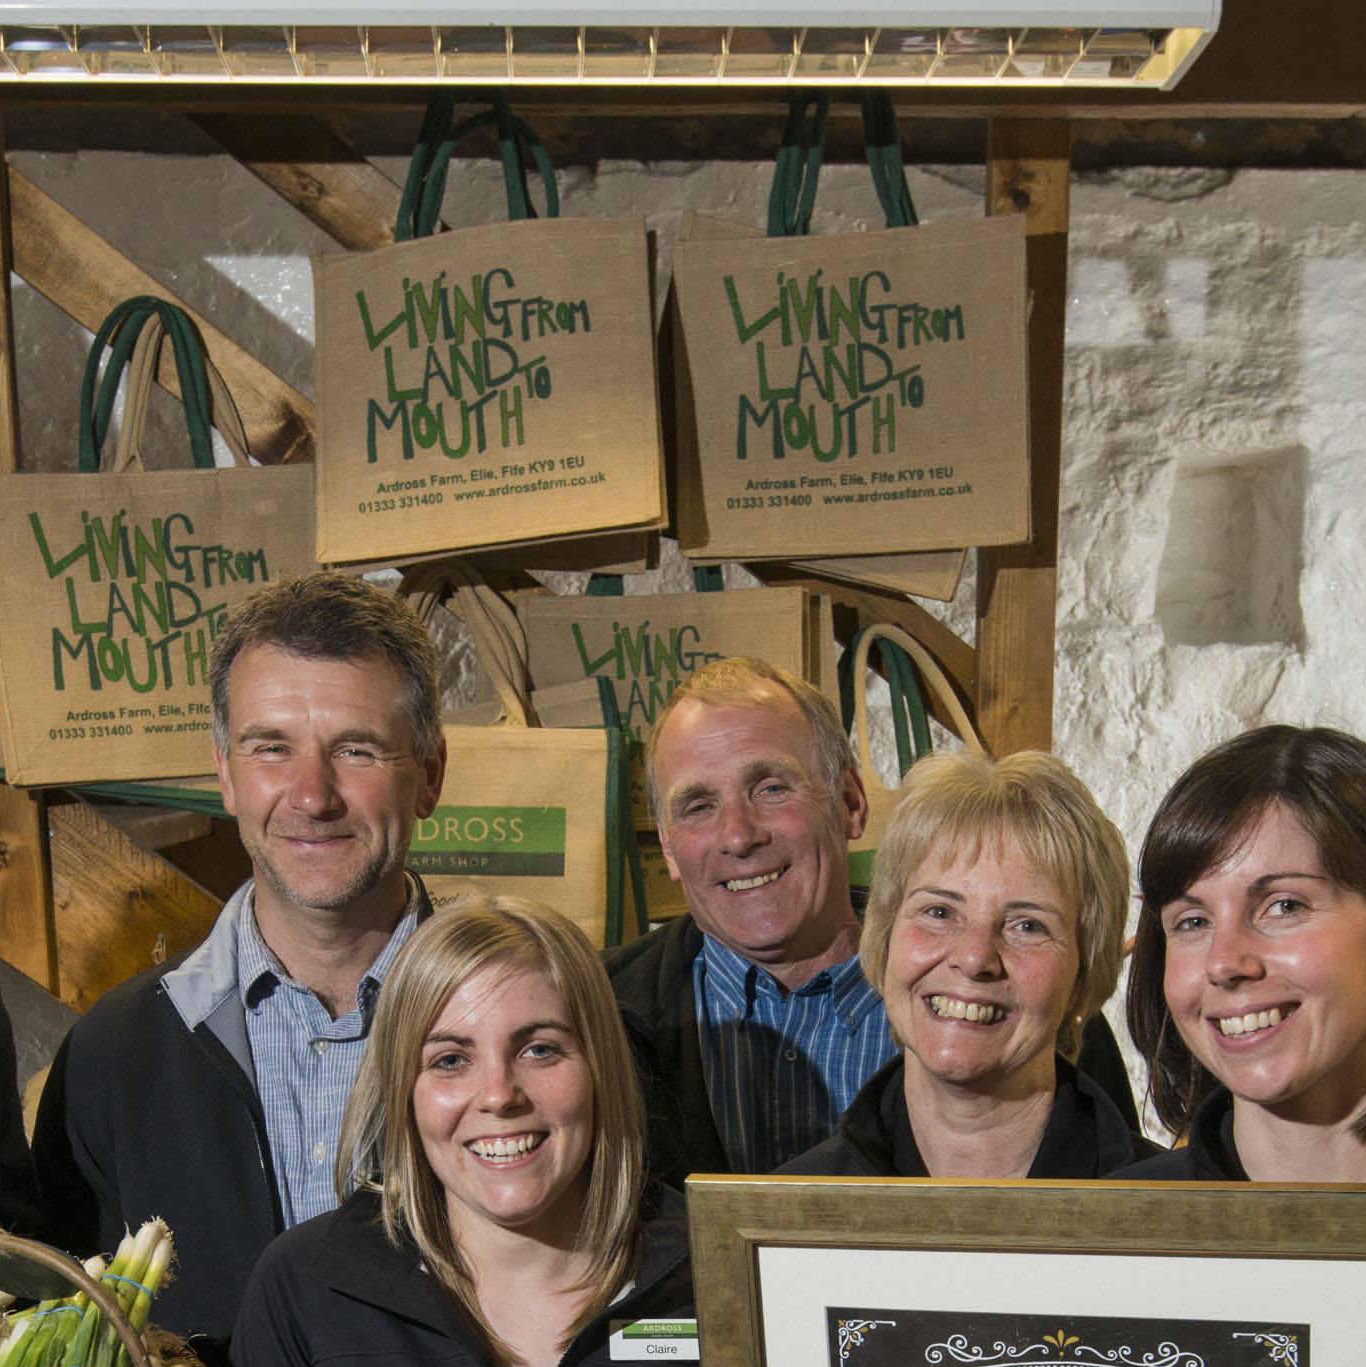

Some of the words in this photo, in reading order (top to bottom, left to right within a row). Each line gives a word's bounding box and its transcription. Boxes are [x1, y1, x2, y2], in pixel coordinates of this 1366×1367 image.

[521, 296, 591, 342] FROM
[897, 303, 965, 349] FROM
[385, 338, 518, 404] LAND
[518, 355, 551, 399] TO
[756, 341, 892, 404] LAND
[892, 364, 924, 408] TO
[367, 386, 525, 464] MOUTH
[737, 393, 896, 462] MOUTH
[359, 498, 396, 513] 01333
[399, 493, 443, 508] 331400
[454, 472, 606, 501] www.ardrossfarm.co.uk
[377, 478, 426, 494] Ardross
[430, 472, 467, 486] Farm,
[470, 469, 498, 482] Elie,
[501, 465, 525, 477] Fife
[528, 460, 555, 473] KY9
[559, 456, 585, 469] 1EU
[745, 479, 796, 491] Ardross
[800, 476, 836, 488] Farm,
[840, 473, 867, 486] Elie,
[871, 471, 895, 484] Fife
[898, 468, 924, 482] KY9
[928, 467, 954, 480] 1EU
[727, 496, 764, 509] 01333
[768, 494, 812, 507] 331400
[823, 483, 973, 505] www.ardrossfarm.co.uk
[203, 545, 269, 588] FROM
[66, 576, 201, 638] LAND
[51, 628, 209, 694] MOUTH
[49, 728, 85, 740] 01333
[89, 724, 133, 738] 331400
[66, 709, 116, 722] Ardross
[119, 706, 155, 719] Farm,
[159, 704, 184, 717] Elie,
[416, 816, 524, 843] DROSS
[404, 856, 442, 867] FARM
[449, 856, 489, 868] SHOP
[643, 1324, 682, 1332] ARDROSS
[646, 1344, 678, 1354] Claire
